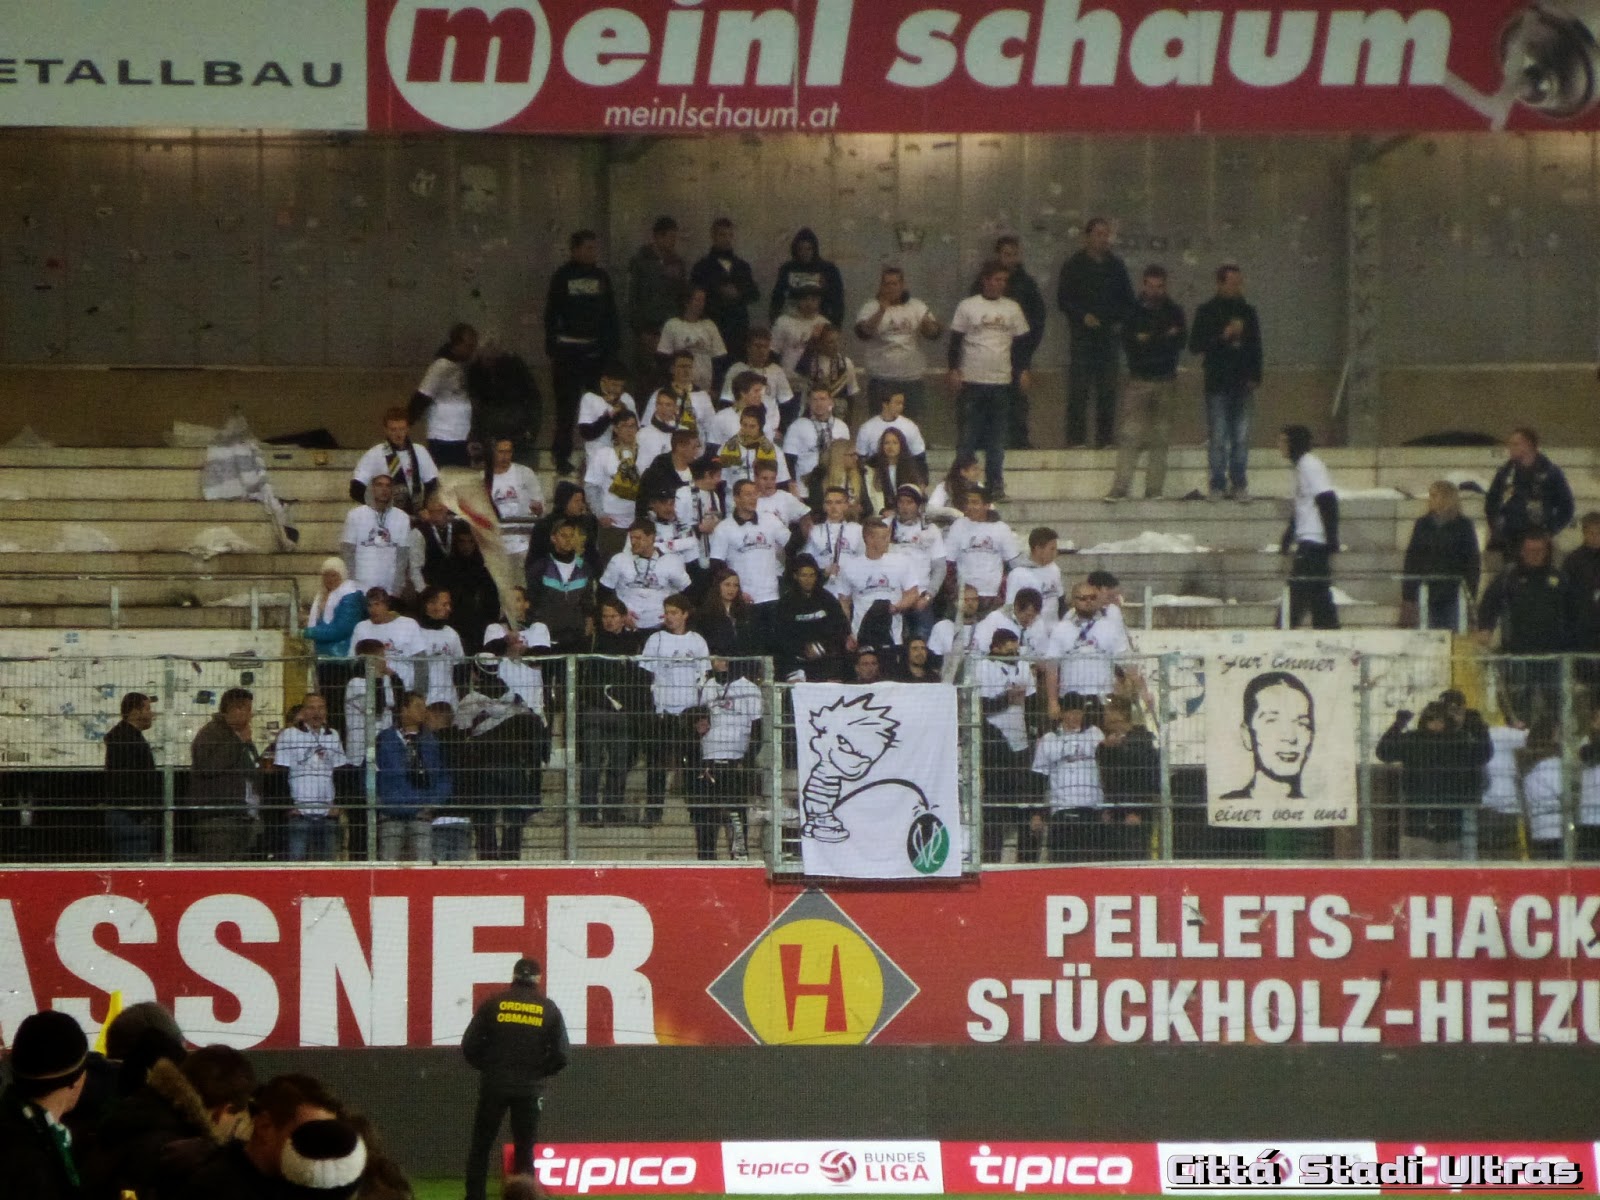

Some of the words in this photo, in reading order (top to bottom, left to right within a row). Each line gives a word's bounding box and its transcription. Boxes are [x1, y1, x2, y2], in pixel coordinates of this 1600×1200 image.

[886, 0, 1452, 86] schaum
[603, 93, 840, 129] meinlschaum.at
[1214, 805, 1261, 822] einer
[1272, 809, 1304, 821] von
[1313, 807, 1348, 821] uns
[499, 1001, 544, 1015] ORDNER
[864, 1152, 926, 1162] BUNDES
[533, 1148, 697, 1193] tipico
[736, 1159, 810, 1179] tipico
[865, 1167, 931, 1182] LIGA
[970, 1145, 1134, 1192] tipico
